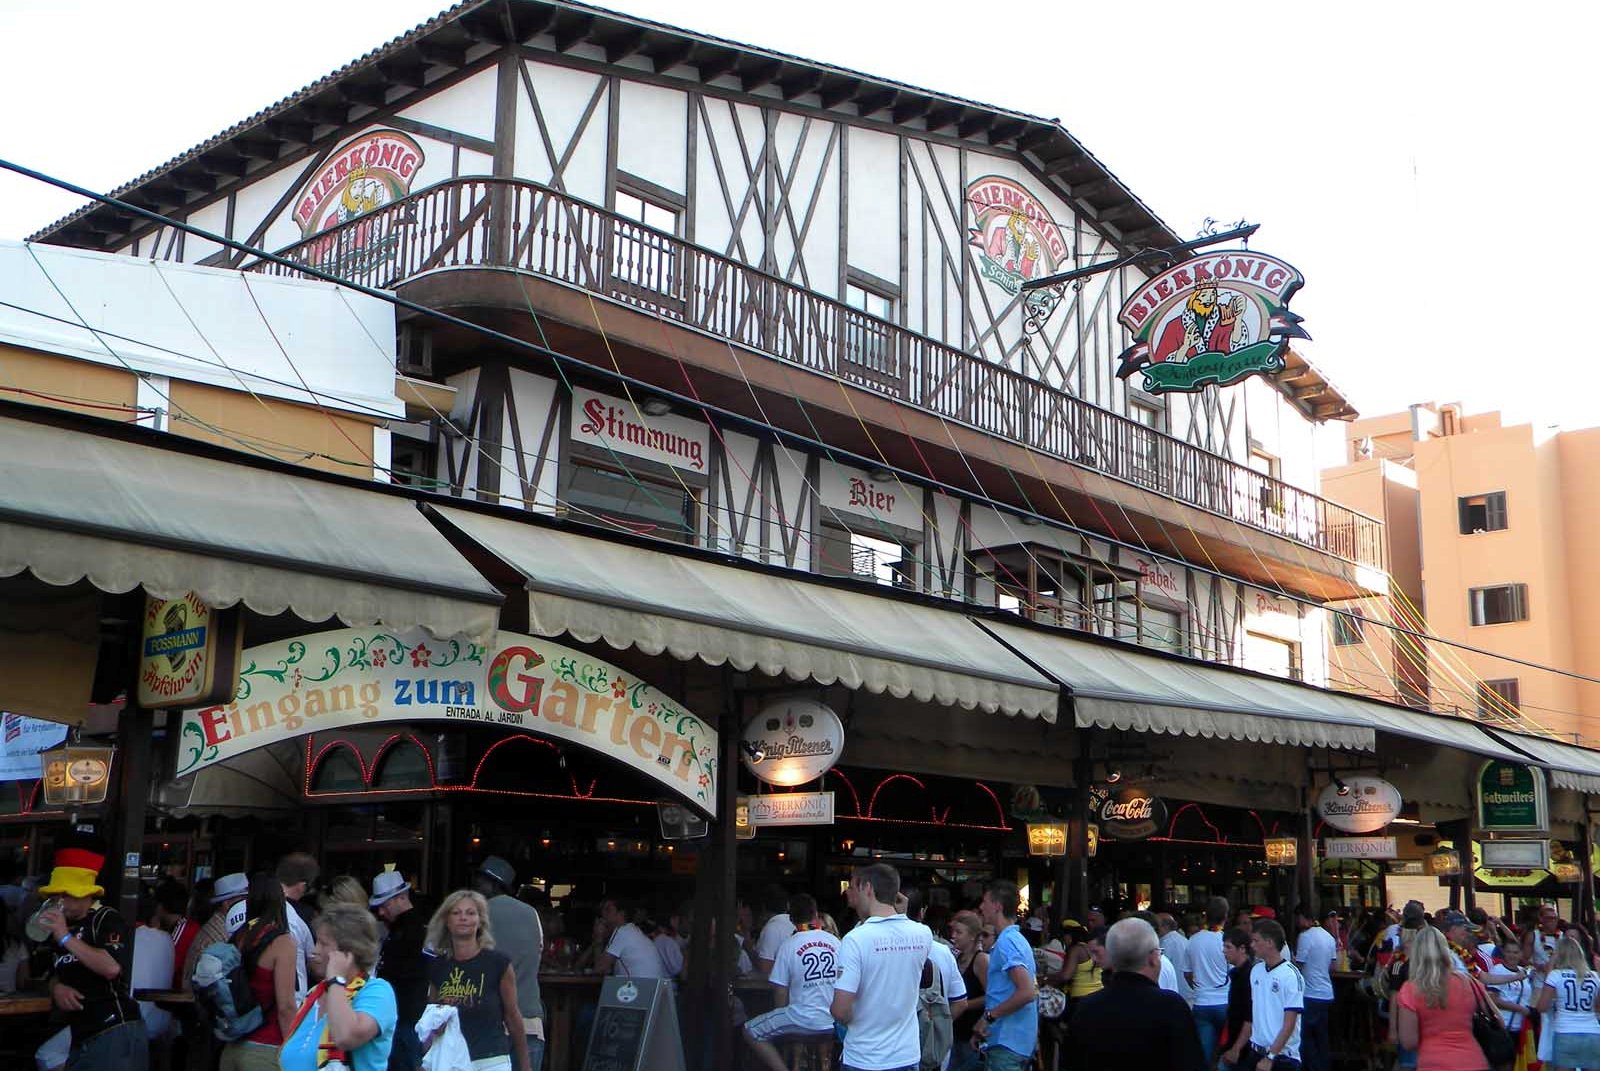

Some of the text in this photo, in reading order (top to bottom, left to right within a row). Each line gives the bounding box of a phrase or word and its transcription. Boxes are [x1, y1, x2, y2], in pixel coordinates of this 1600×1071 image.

[299, 138, 417, 222] BIERKÖNIG
[972, 185, 1063, 258] BIERKÖNIG
[1128, 255, 1287, 323] BIERKÖNIG
[581, 398, 704, 470] Stimmung
[848, 477, 896, 513] Bier
[198, 645, 693, 783] Eingang zum Garten
[446, 706, 523, 724] ENTRADA AL JARDIN
[771, 797, 826, 811] BIERKÖNIG
[802, 952, 836, 981] 22
[1563, 979, 1598, 1012] 13
